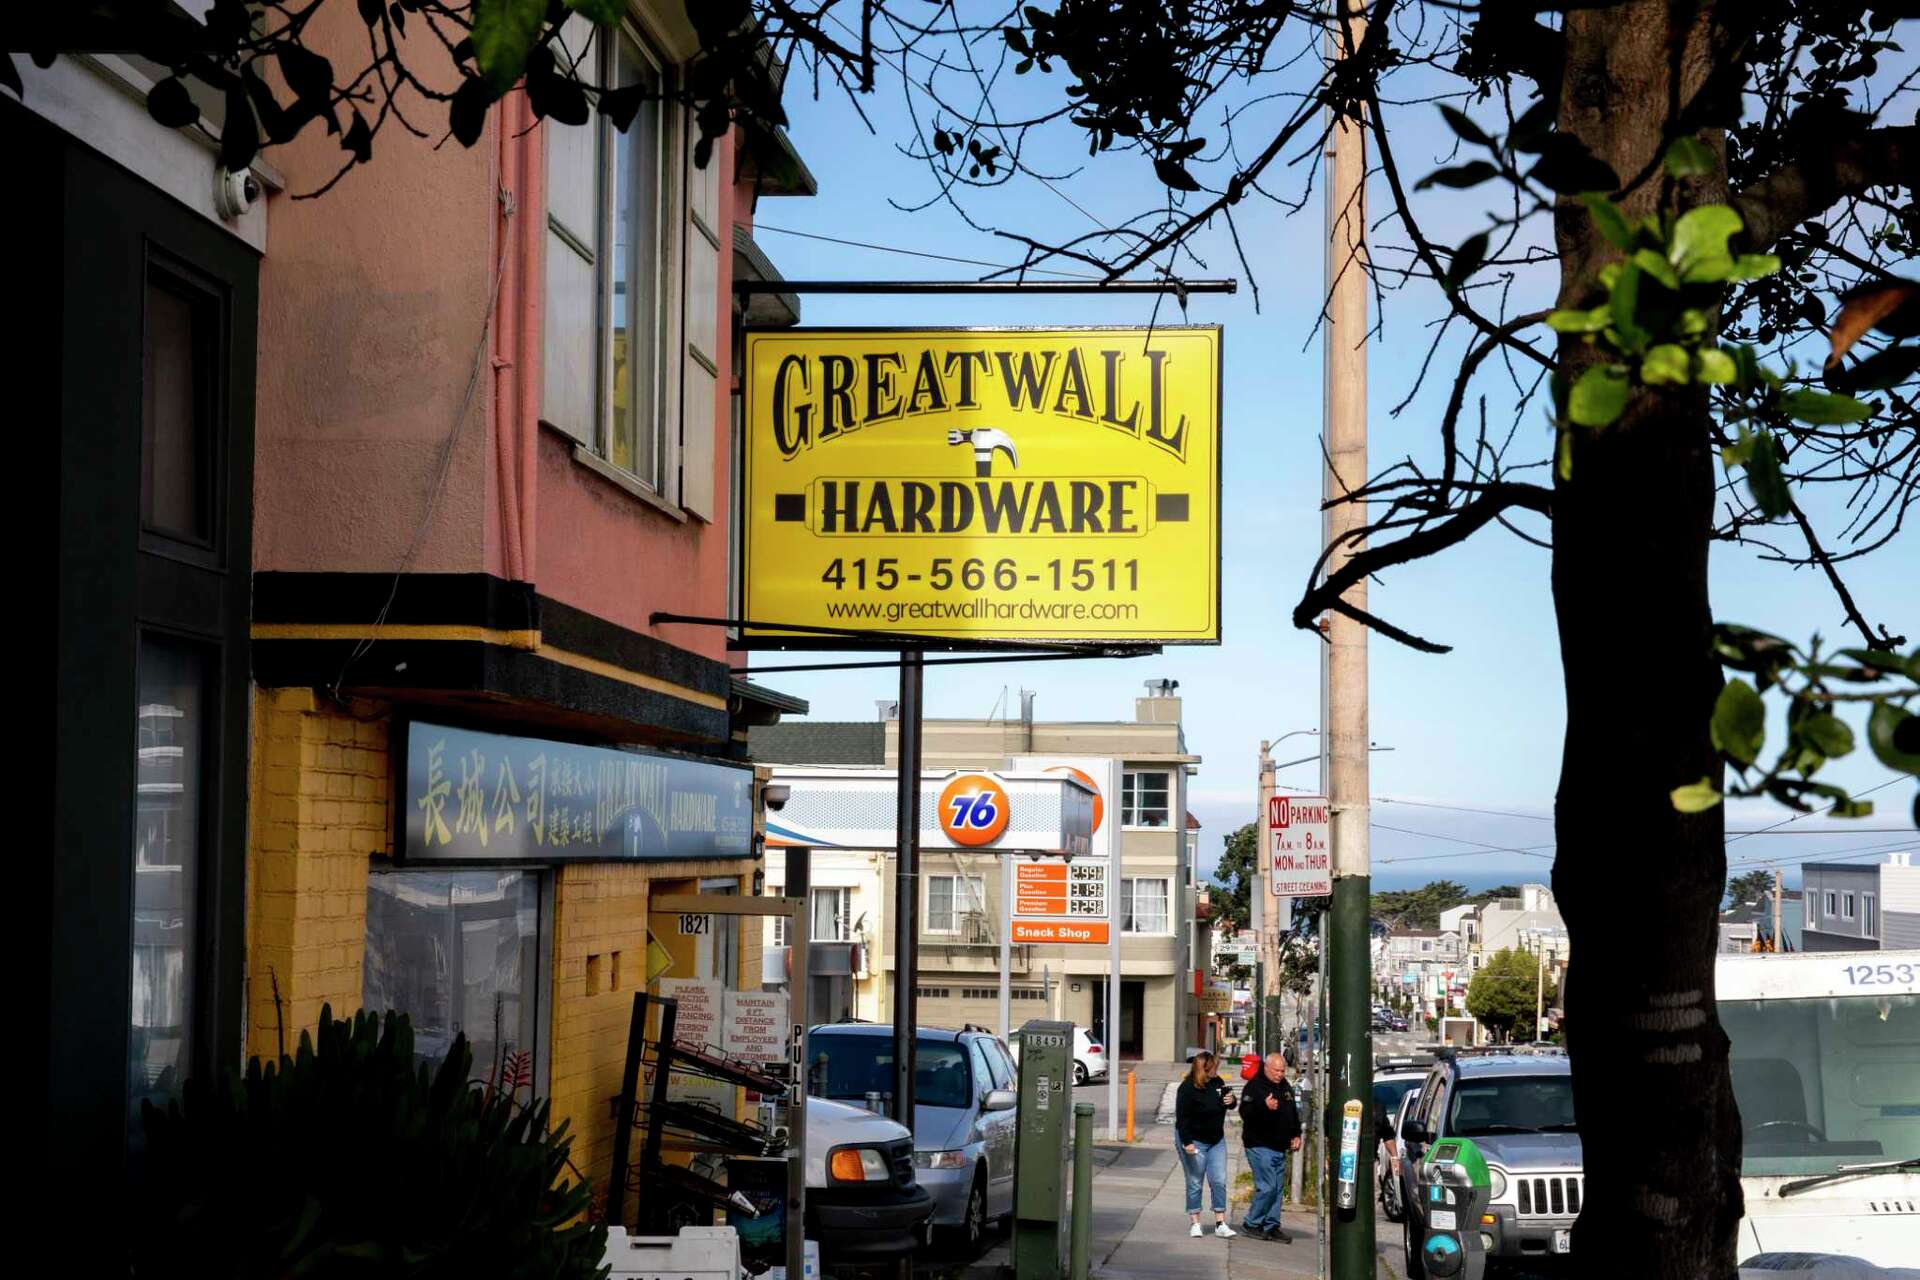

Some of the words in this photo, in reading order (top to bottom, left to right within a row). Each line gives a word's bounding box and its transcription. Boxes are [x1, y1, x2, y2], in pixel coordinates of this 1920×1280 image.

[820, 481, 1138, 534] HARDWARE
[821, 557, 1138, 592] 415-566-1511
[826, 597, 1138, 624] www.greatwallhardware.com
[671, 791, 717, 832] HARDWARE
[949, 790, 998, 829] 76
[1271, 800, 1288, 824] NO
[1290, 805, 1328, 824] PARKING
[1275, 855, 1295, 870] MON
[1304, 855, 1327, 870] THUR
[1276, 882, 1298, 892] STREET
[1299, 881, 1327, 891] CLEANING
[679, 914, 710, 934] 1821
[1016, 926, 1054, 937] Snack
[1058, 927, 1091, 939] Shop
[735, 999, 775, 1007] MAINTAIN
